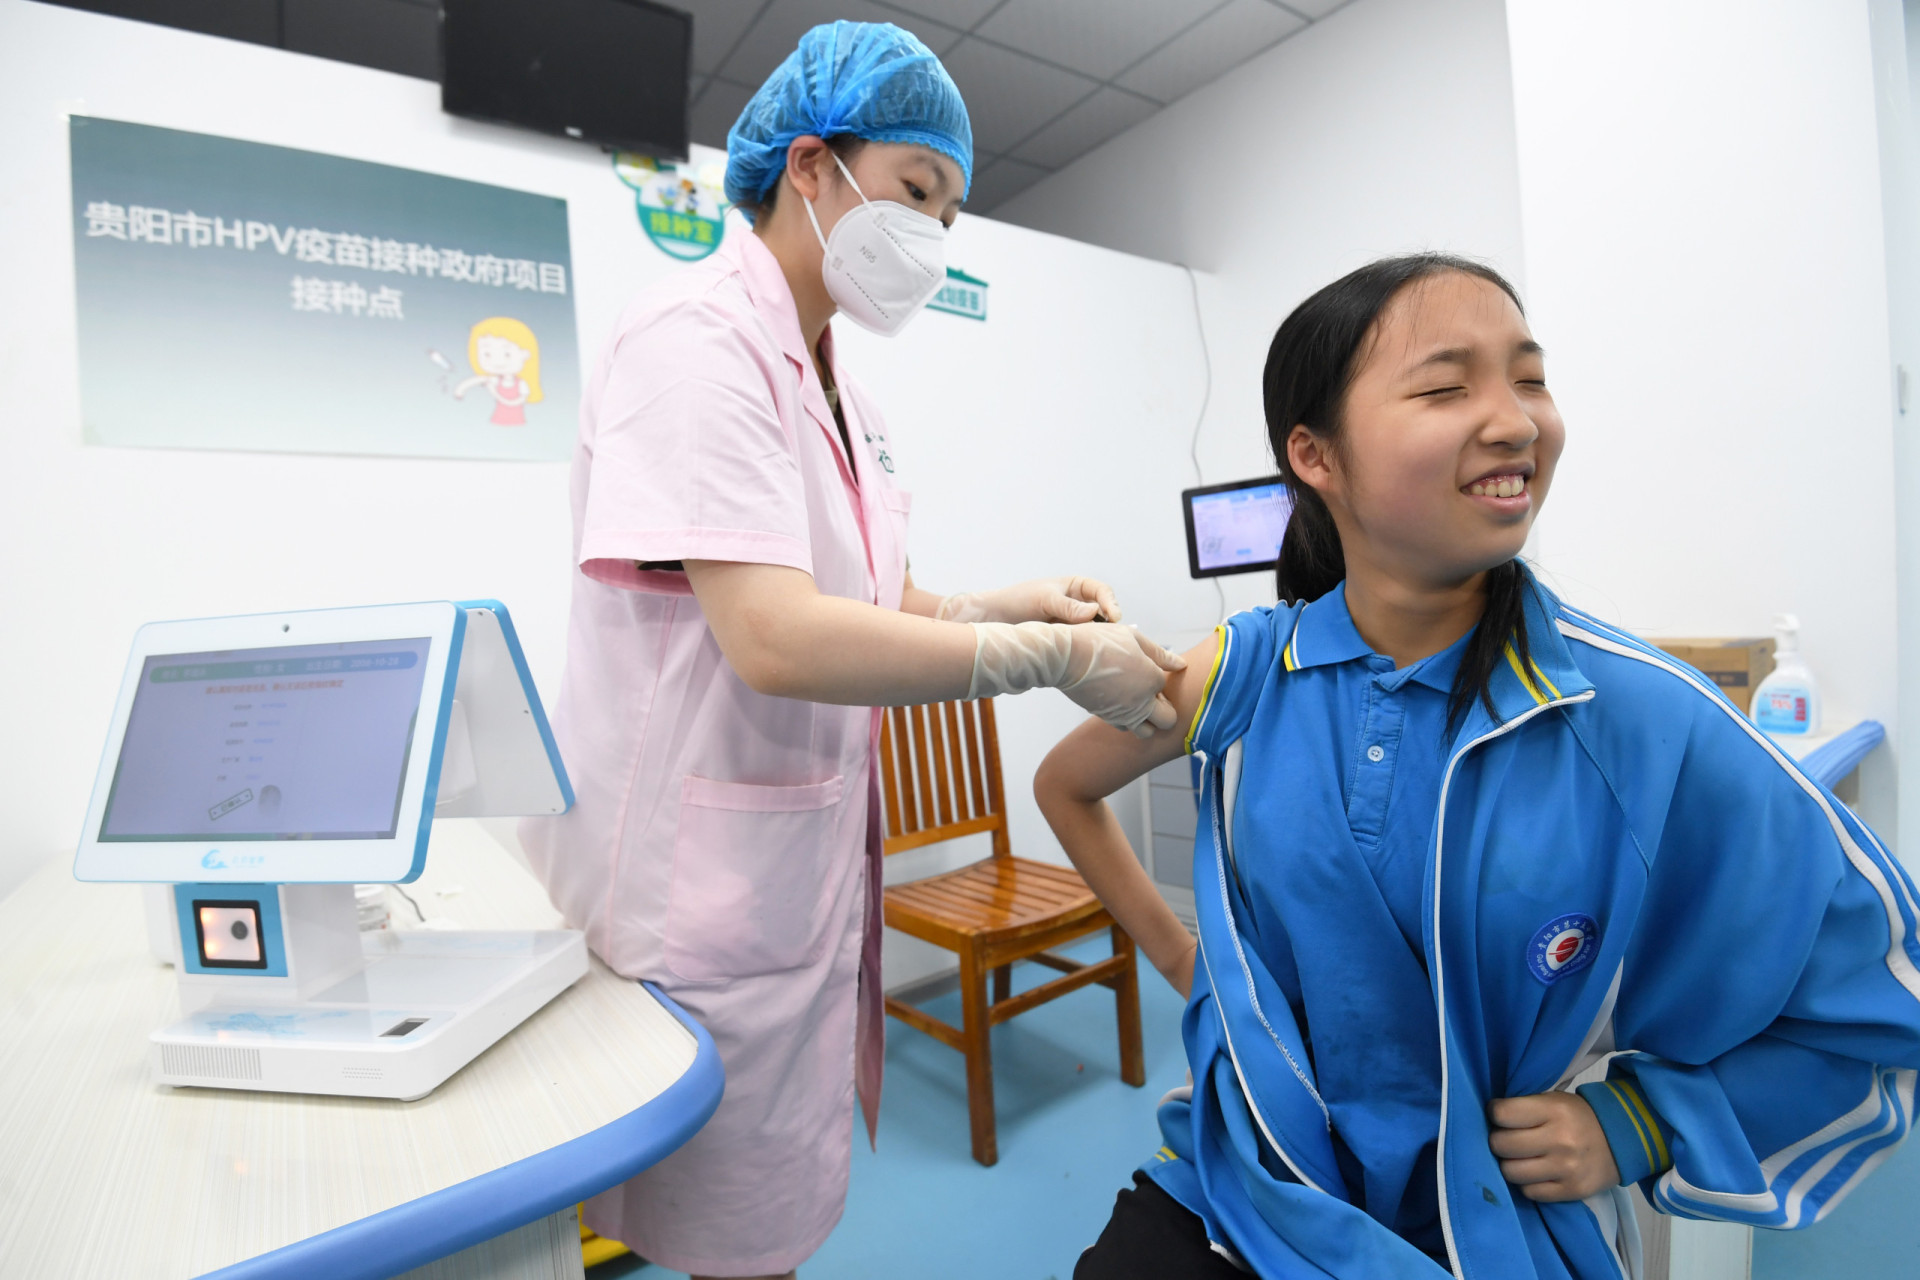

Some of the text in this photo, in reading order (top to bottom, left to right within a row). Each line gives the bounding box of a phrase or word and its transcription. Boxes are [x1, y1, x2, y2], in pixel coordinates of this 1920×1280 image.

[84, 201, 567, 294] 贵阳市HPV疫苗接种政府项目
[859, 246, 877, 263] N95
[290, 275, 404, 320] 接种点
